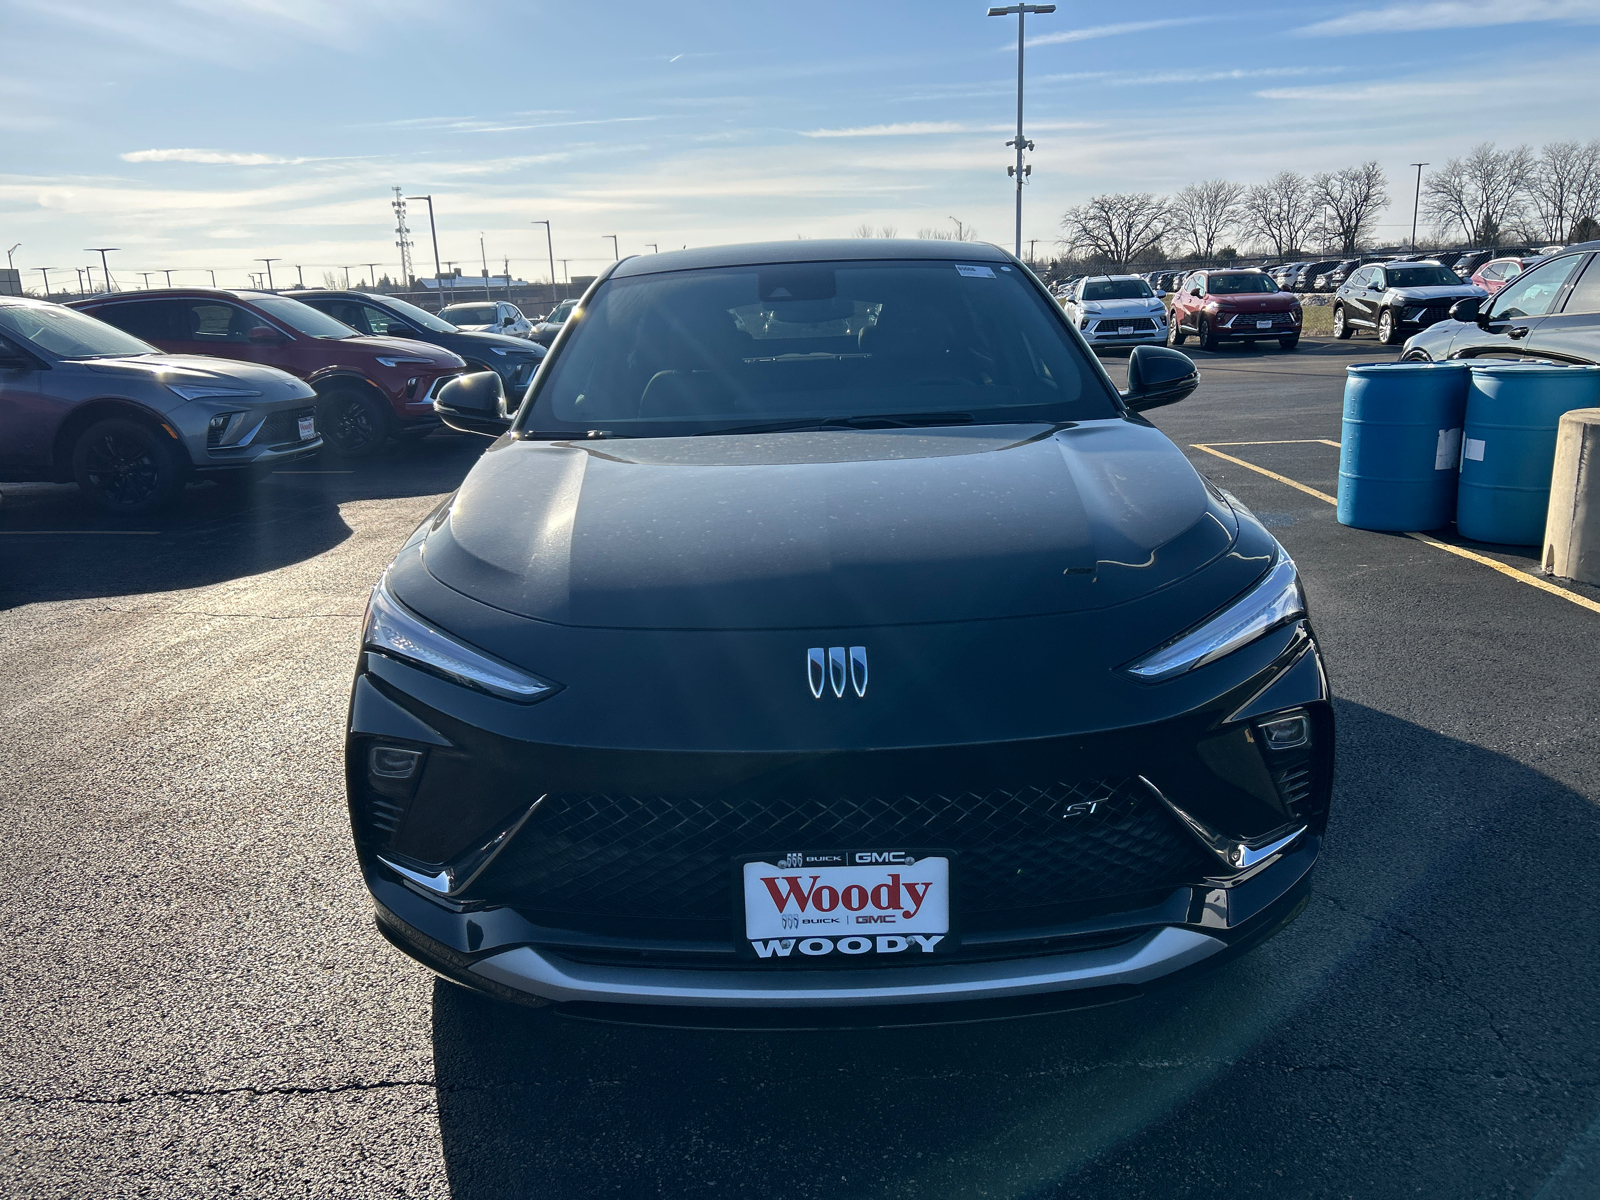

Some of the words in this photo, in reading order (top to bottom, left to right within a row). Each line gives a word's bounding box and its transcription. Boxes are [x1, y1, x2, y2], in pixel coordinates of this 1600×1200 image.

[855, 851, 906, 863] GMC
[759, 873, 933, 919] Woody
[802, 917, 840, 925] BUICK
[855, 914, 896, 924] GMC
[751, 935, 945, 958] WOODY
